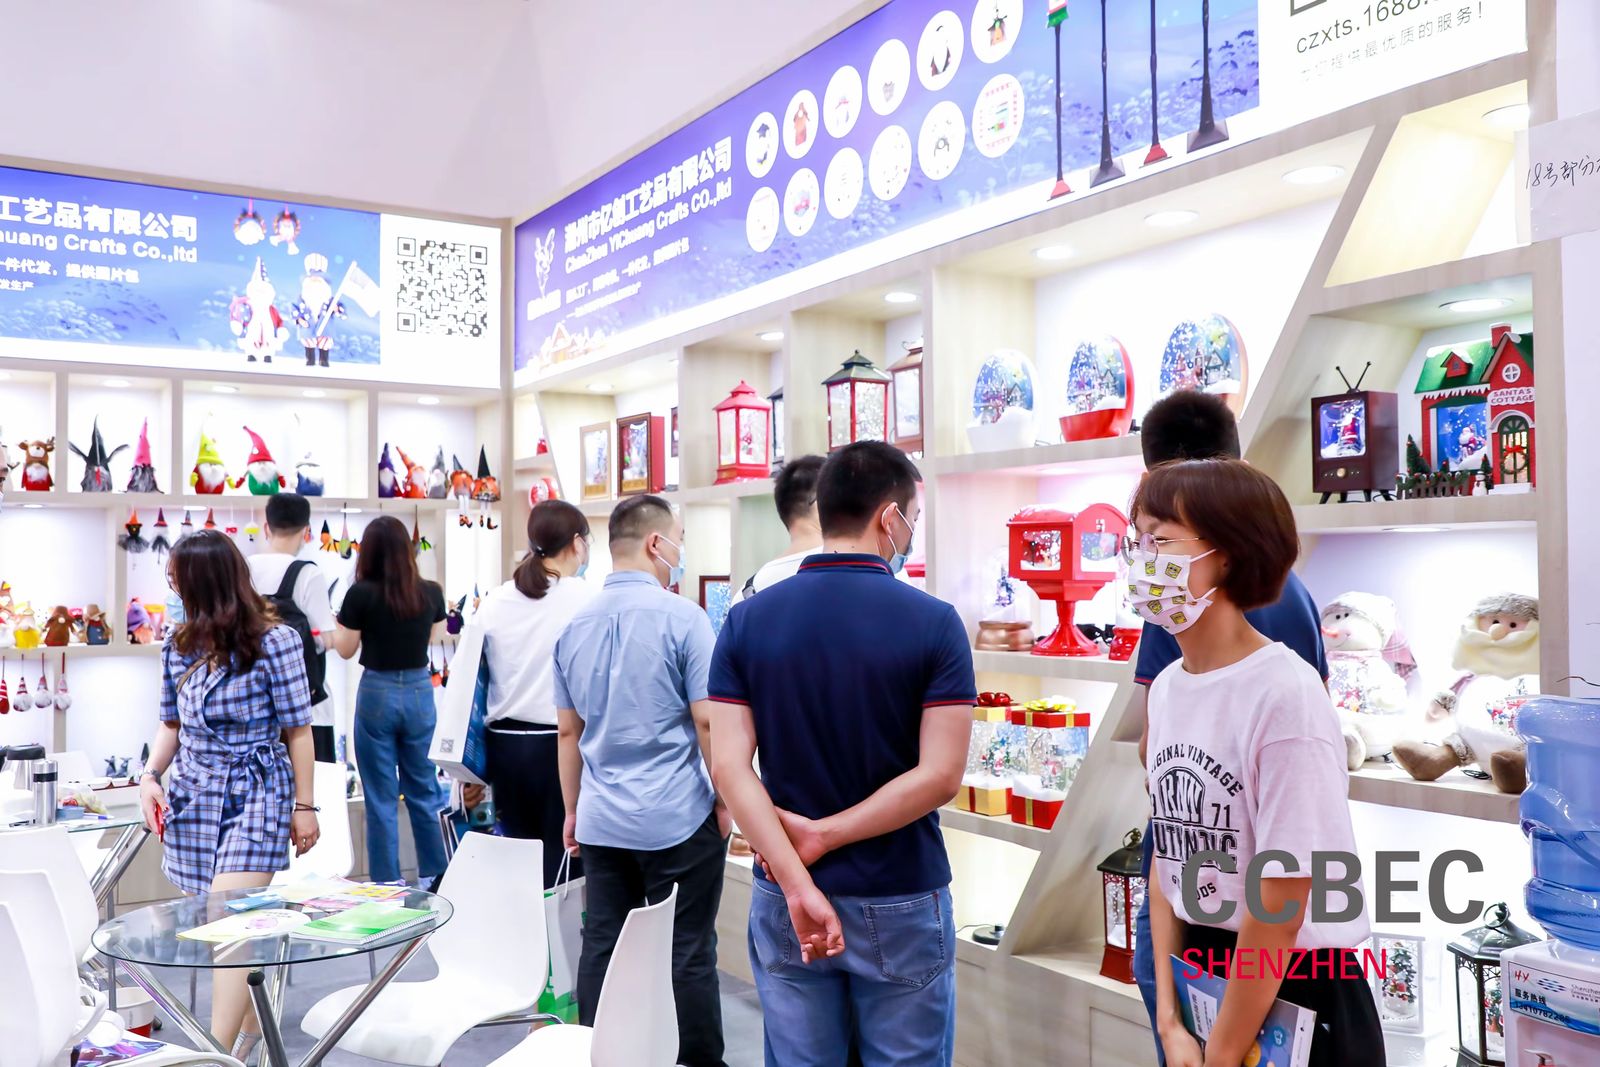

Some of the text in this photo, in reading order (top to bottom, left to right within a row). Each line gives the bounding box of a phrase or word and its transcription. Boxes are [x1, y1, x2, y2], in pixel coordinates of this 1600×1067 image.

[1296, 0, 1440, 53] czxts.1688.
[63, 233, 127, 256] Crafts
[1491, 394, 1534, 404] COTTAGE
[1493, 388, 1532, 398] SANTA'S
[1187, 744, 1244, 798] VINTAGE
[1211, 802, 1231, 829] 71
